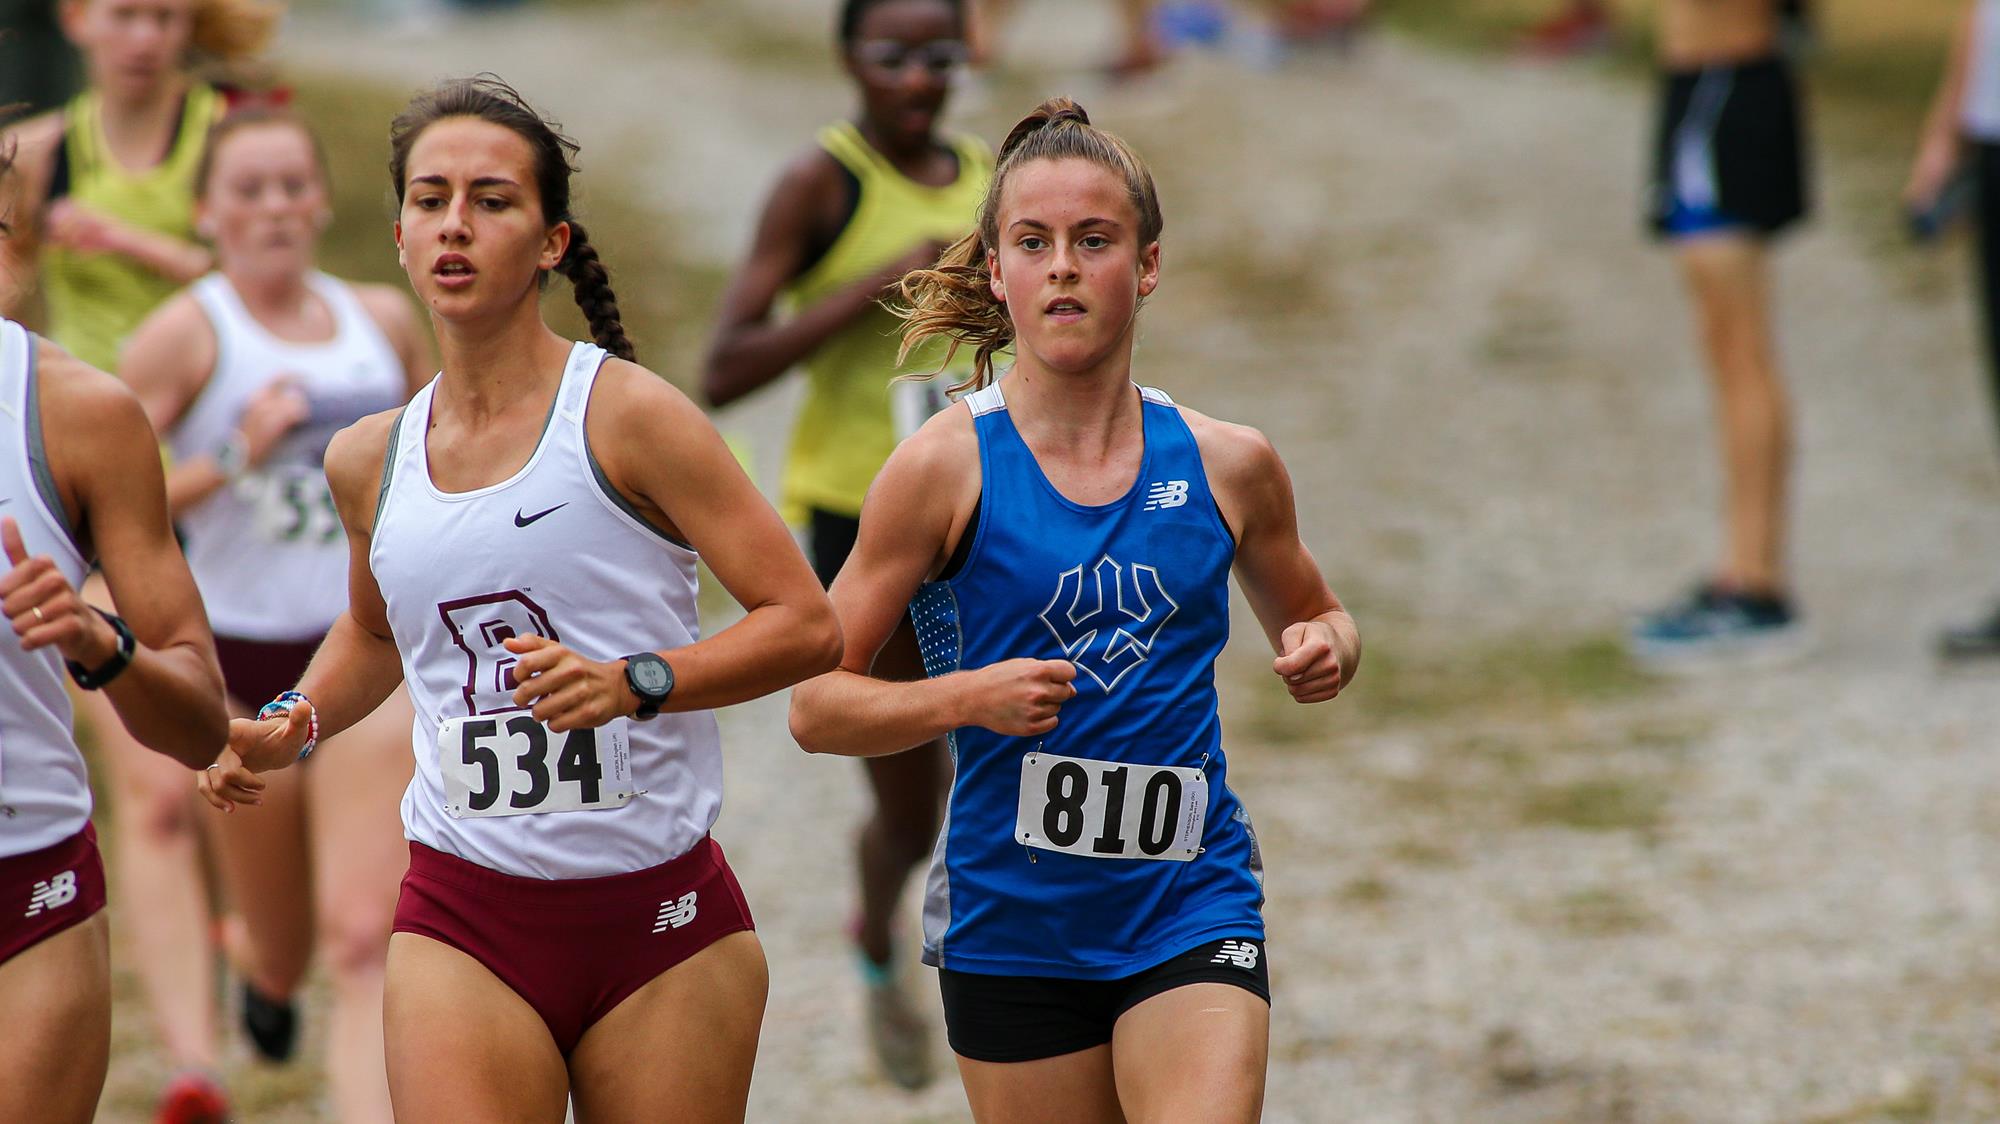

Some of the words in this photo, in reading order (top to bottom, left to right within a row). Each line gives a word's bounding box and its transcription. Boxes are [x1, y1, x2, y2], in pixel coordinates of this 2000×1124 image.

[1144, 480, 1189, 511] NB
[462, 716, 602, 811] 534
[1043, 761, 1182, 855] 810
[25, 870, 77, 918] NB
[652, 891, 697, 933] NB
[1210, 940, 1259, 969] NB
